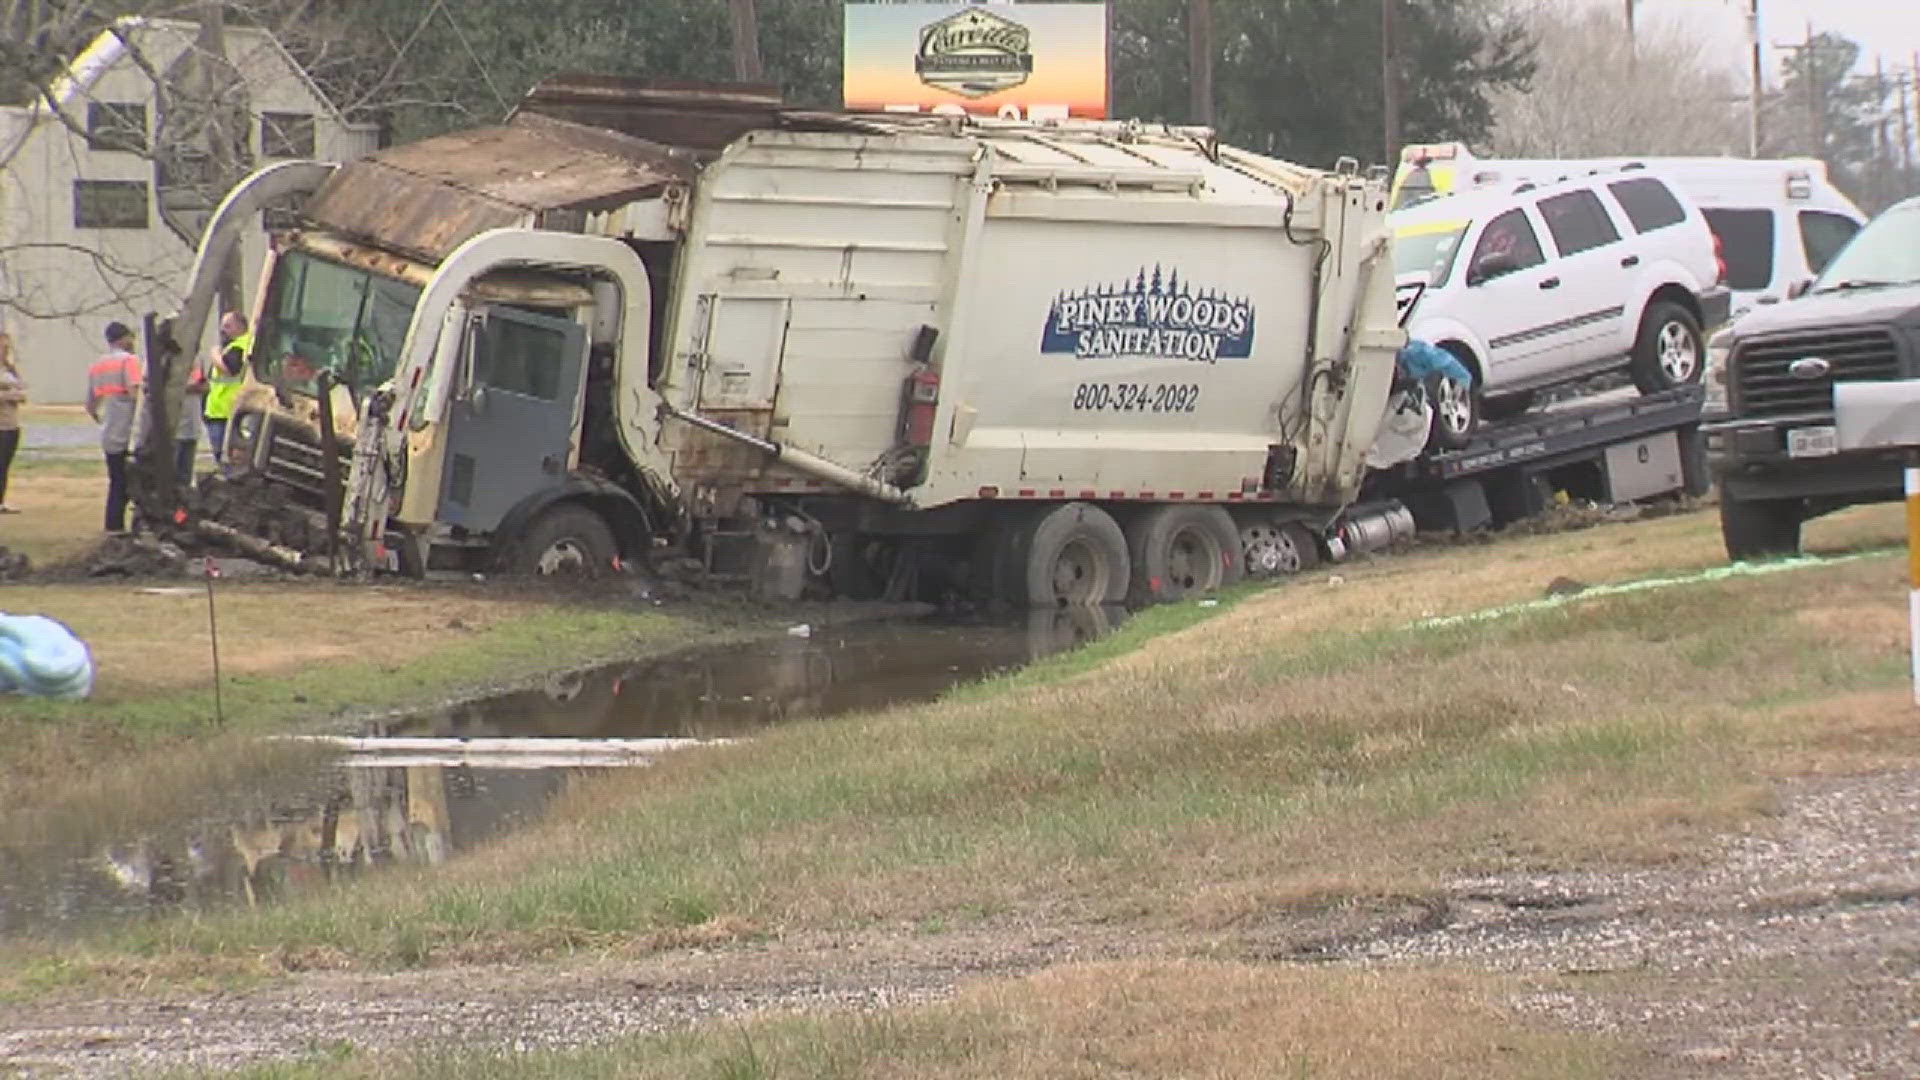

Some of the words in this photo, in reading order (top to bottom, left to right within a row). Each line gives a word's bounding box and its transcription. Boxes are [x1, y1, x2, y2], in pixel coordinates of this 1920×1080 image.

[1058, 296, 1143, 331] PINEY
[1147, 297, 1248, 335] WOODS
[1076, 328, 1221, 362] SANITATION
[1073, 383, 1199, 413] 800-324-2092
